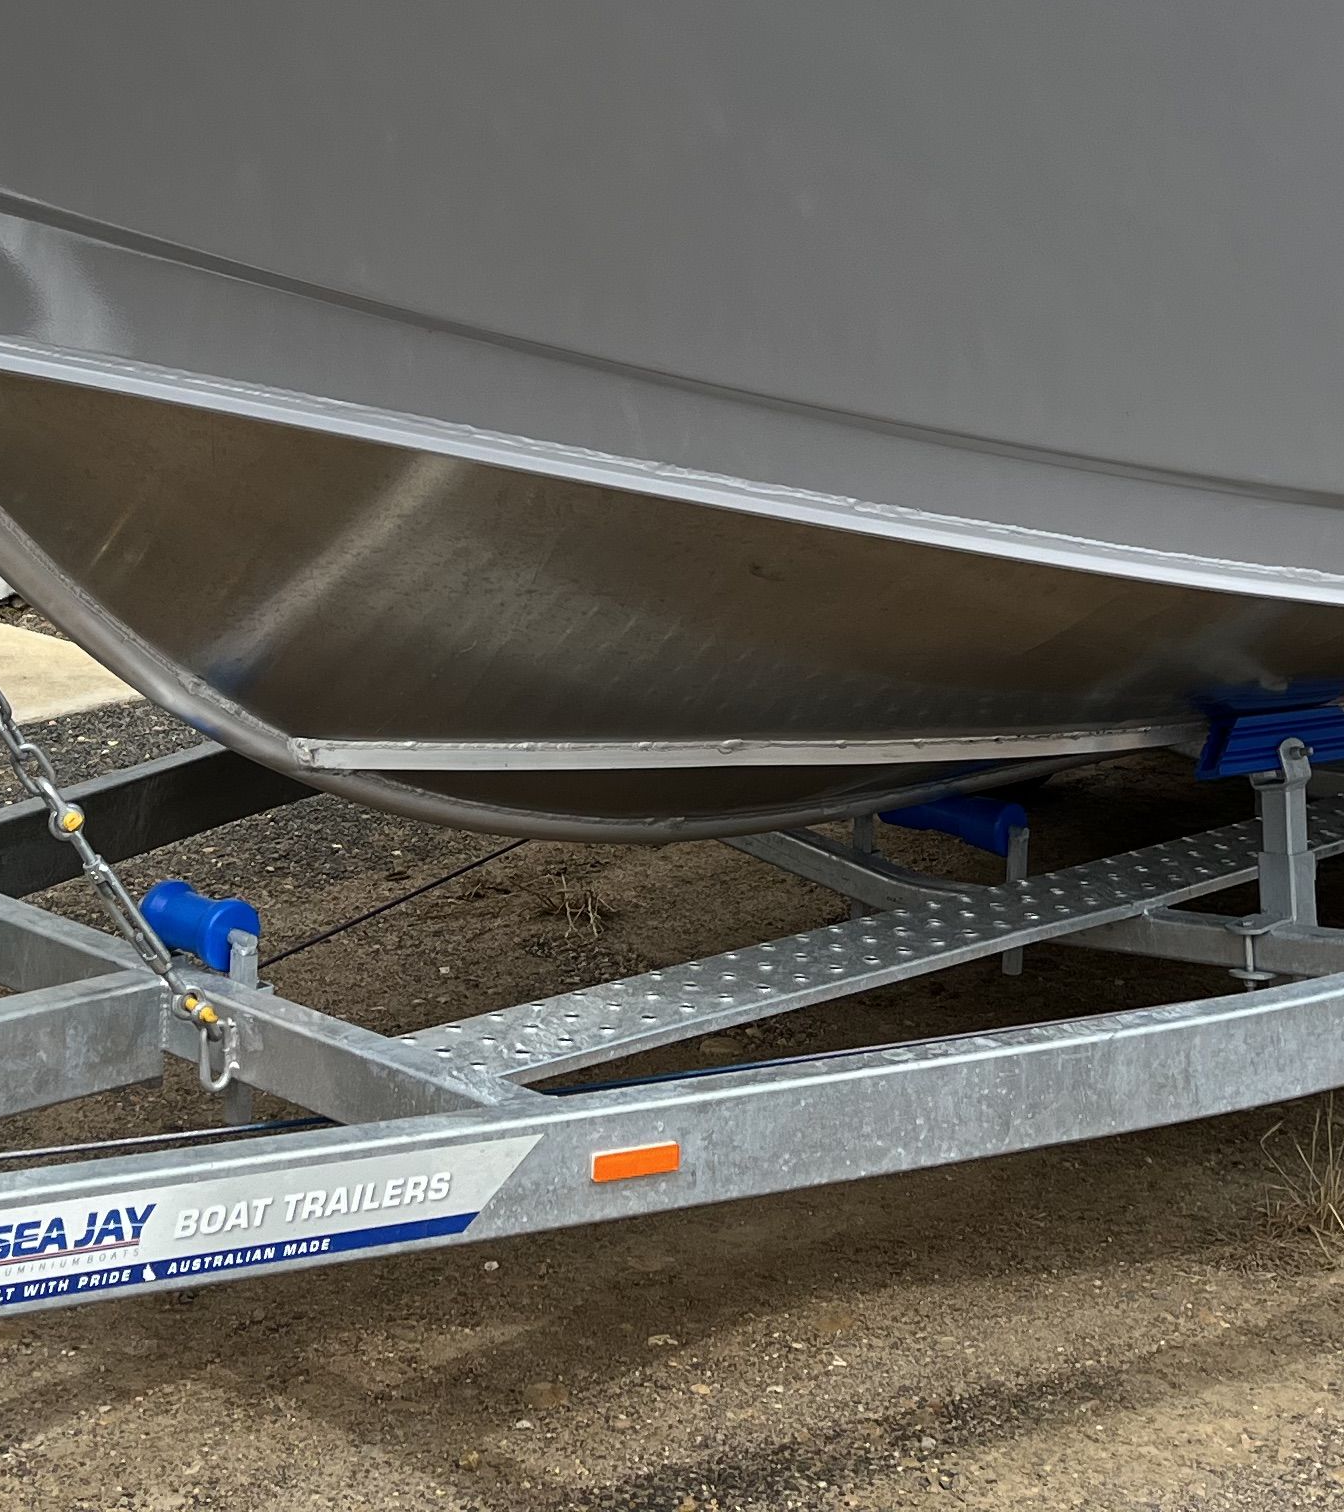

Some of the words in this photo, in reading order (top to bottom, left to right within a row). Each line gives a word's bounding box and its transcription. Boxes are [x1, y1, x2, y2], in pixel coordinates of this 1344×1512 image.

[74, 1204, 156, 1247] JAY
[173, 1197, 274, 1239] BOAT
[283, 1172, 452, 1223] TRAILERS
[23, 1279, 70, 1298] WITH
[77, 1270, 132, 1289] PRIDE
[166, 1247, 276, 1275] AUSTRALIAN
[283, 1239, 331, 1257] MADE
[86, 1248, 140, 1265] BOATS
